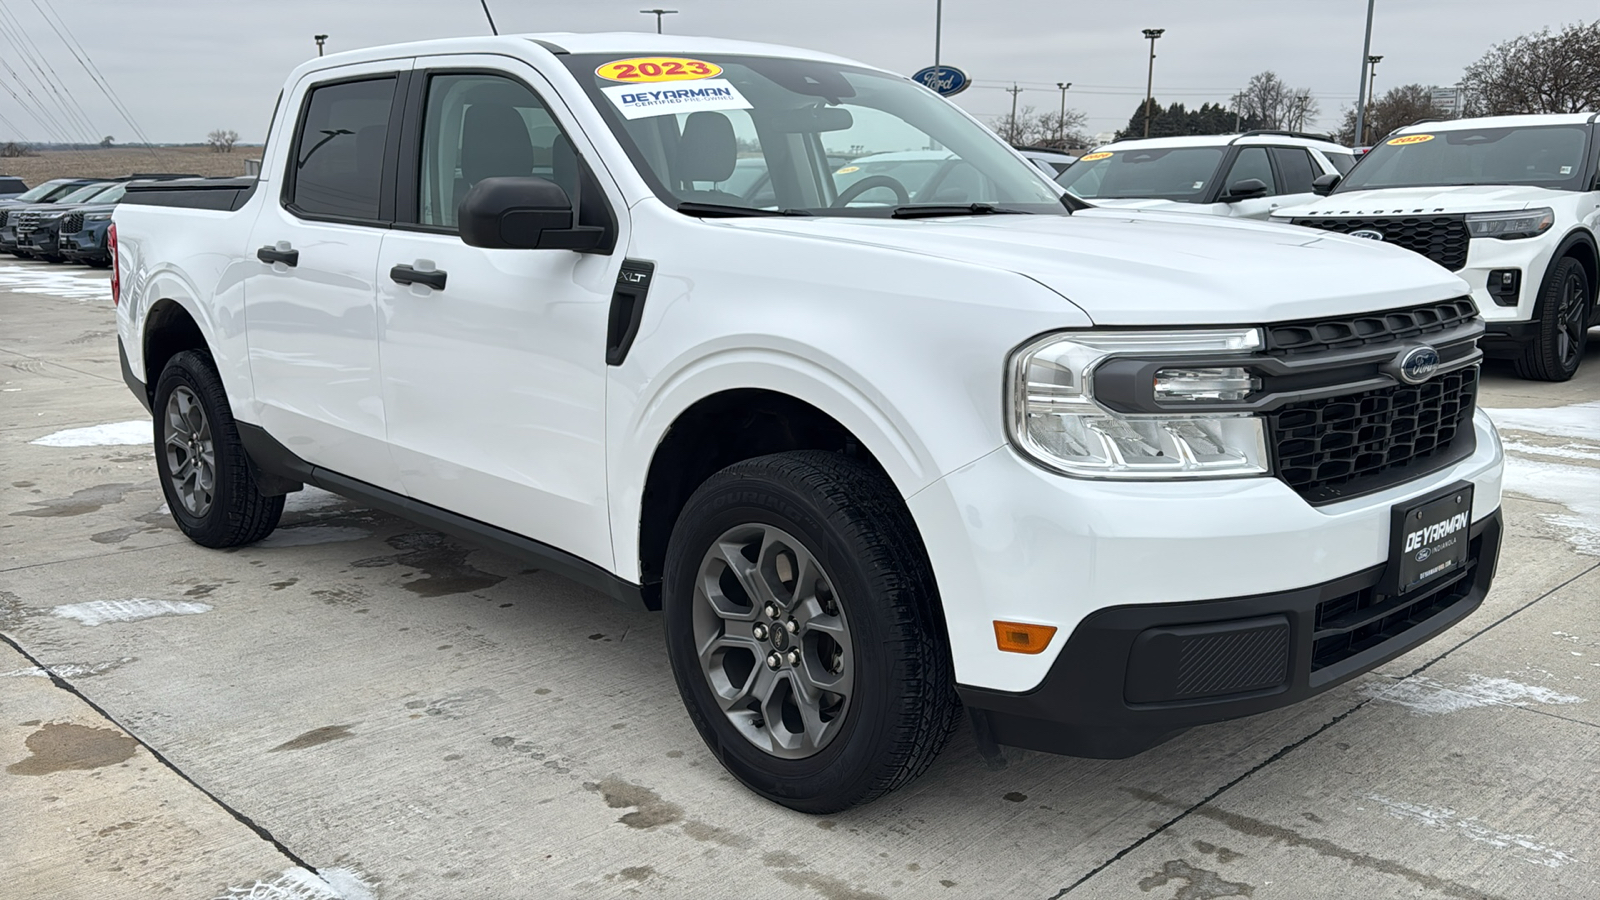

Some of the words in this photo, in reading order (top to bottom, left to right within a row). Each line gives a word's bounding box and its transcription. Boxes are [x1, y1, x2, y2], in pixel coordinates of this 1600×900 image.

[613, 61, 712, 79] 2023
[921, 71, 955, 91] Ford
[620, 87, 731, 104] DEYARMAN
[634, 98, 682, 108] CERTIFIED
[684, 95, 735, 103] PRE-OWNED
[1308, 208, 1445, 216] EXPLORER
[618, 271, 647, 283] XLT
[1404, 510, 1469, 554] DEYARMAN
[1431, 537, 1457, 555] INDIANOLA
